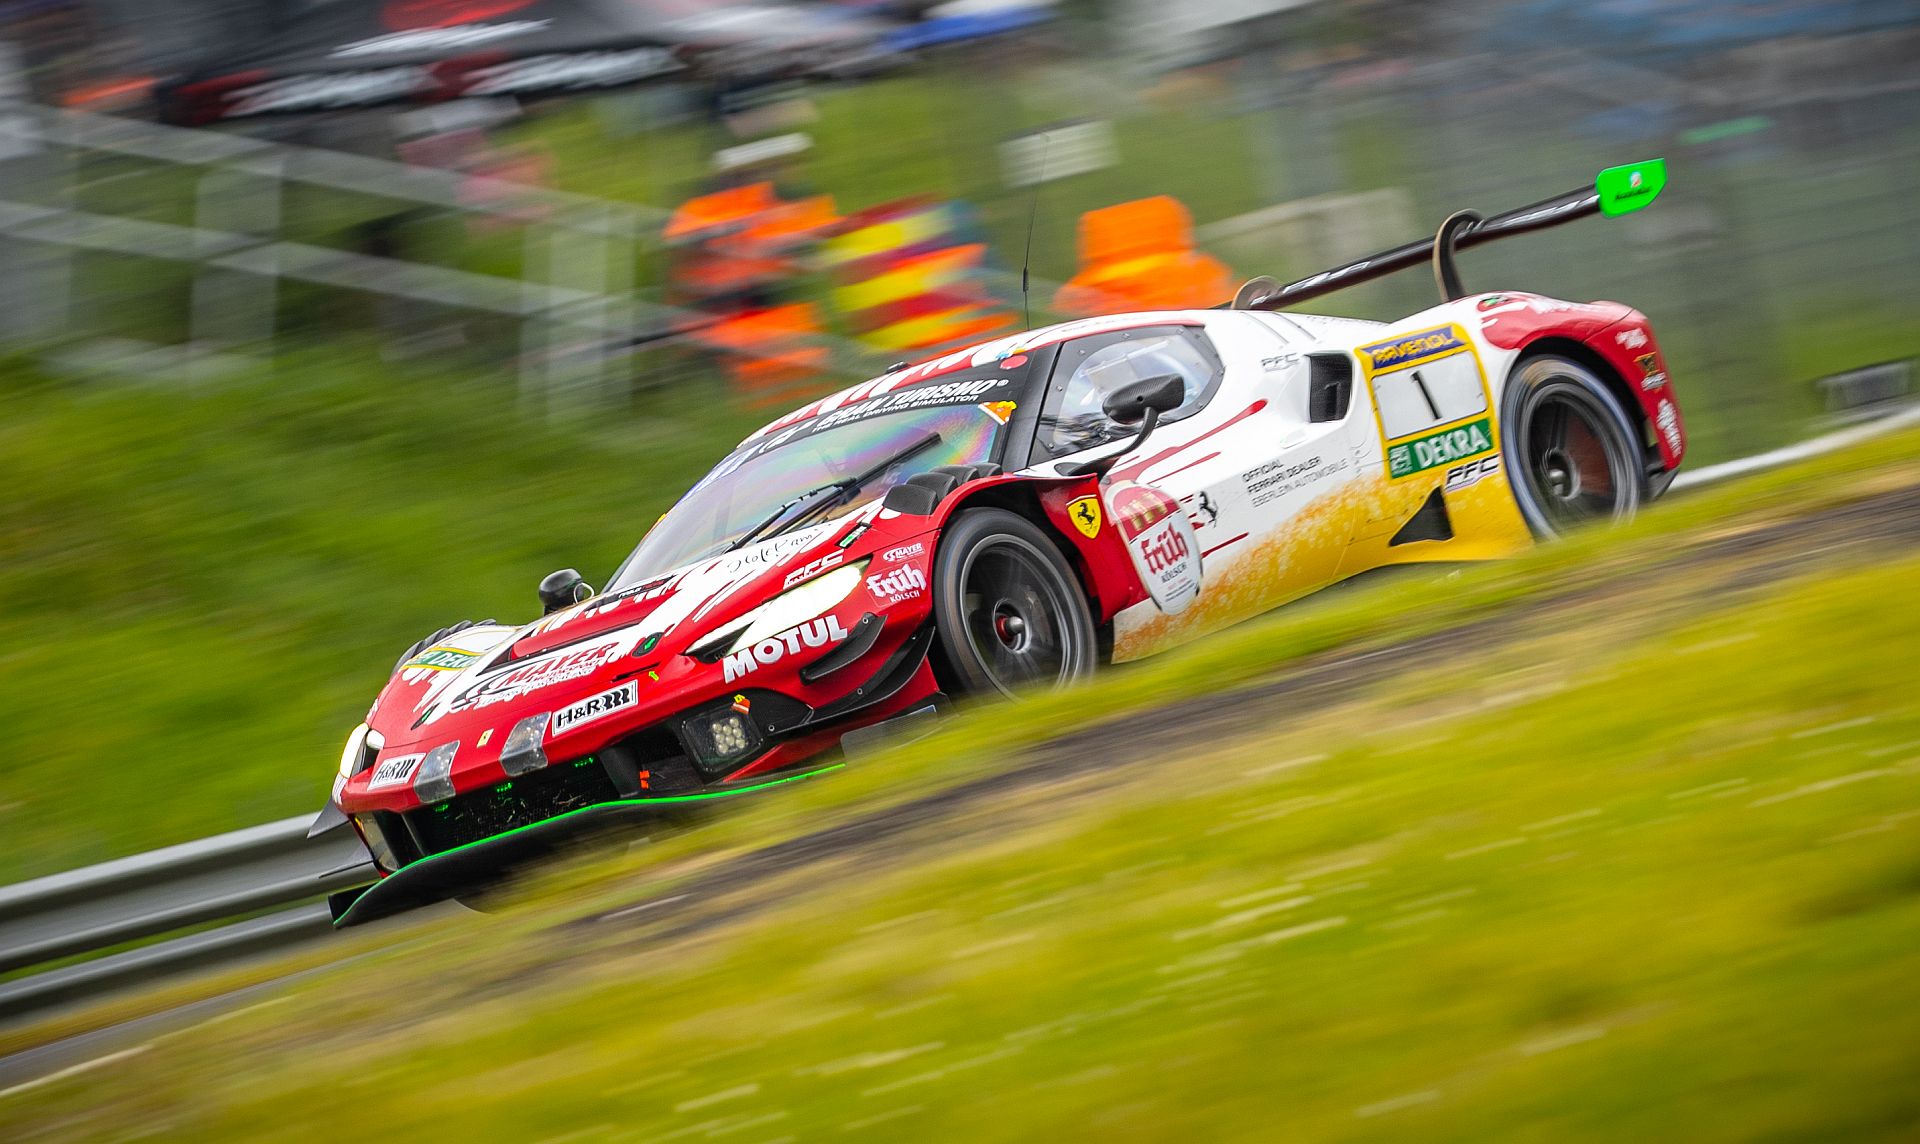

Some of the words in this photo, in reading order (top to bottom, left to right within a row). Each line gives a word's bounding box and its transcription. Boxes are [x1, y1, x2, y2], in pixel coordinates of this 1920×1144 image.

[816, 394, 890, 428] GRAN
[886, 379, 999, 406] TURISMO
[862, 401, 909, 420] DRIVING
[908, 393, 979, 411] SIMULATOR
[1410, 370, 1443, 421] 1
[1413, 424, 1491, 469] DEKRA
[1247, 471, 1286, 493] FERRARI
[1285, 455, 1322, 478] DEALER
[1446, 454, 1499, 486] PFC
[722, 614, 848, 685] MOTUL
[555, 698, 602, 730] H&R
